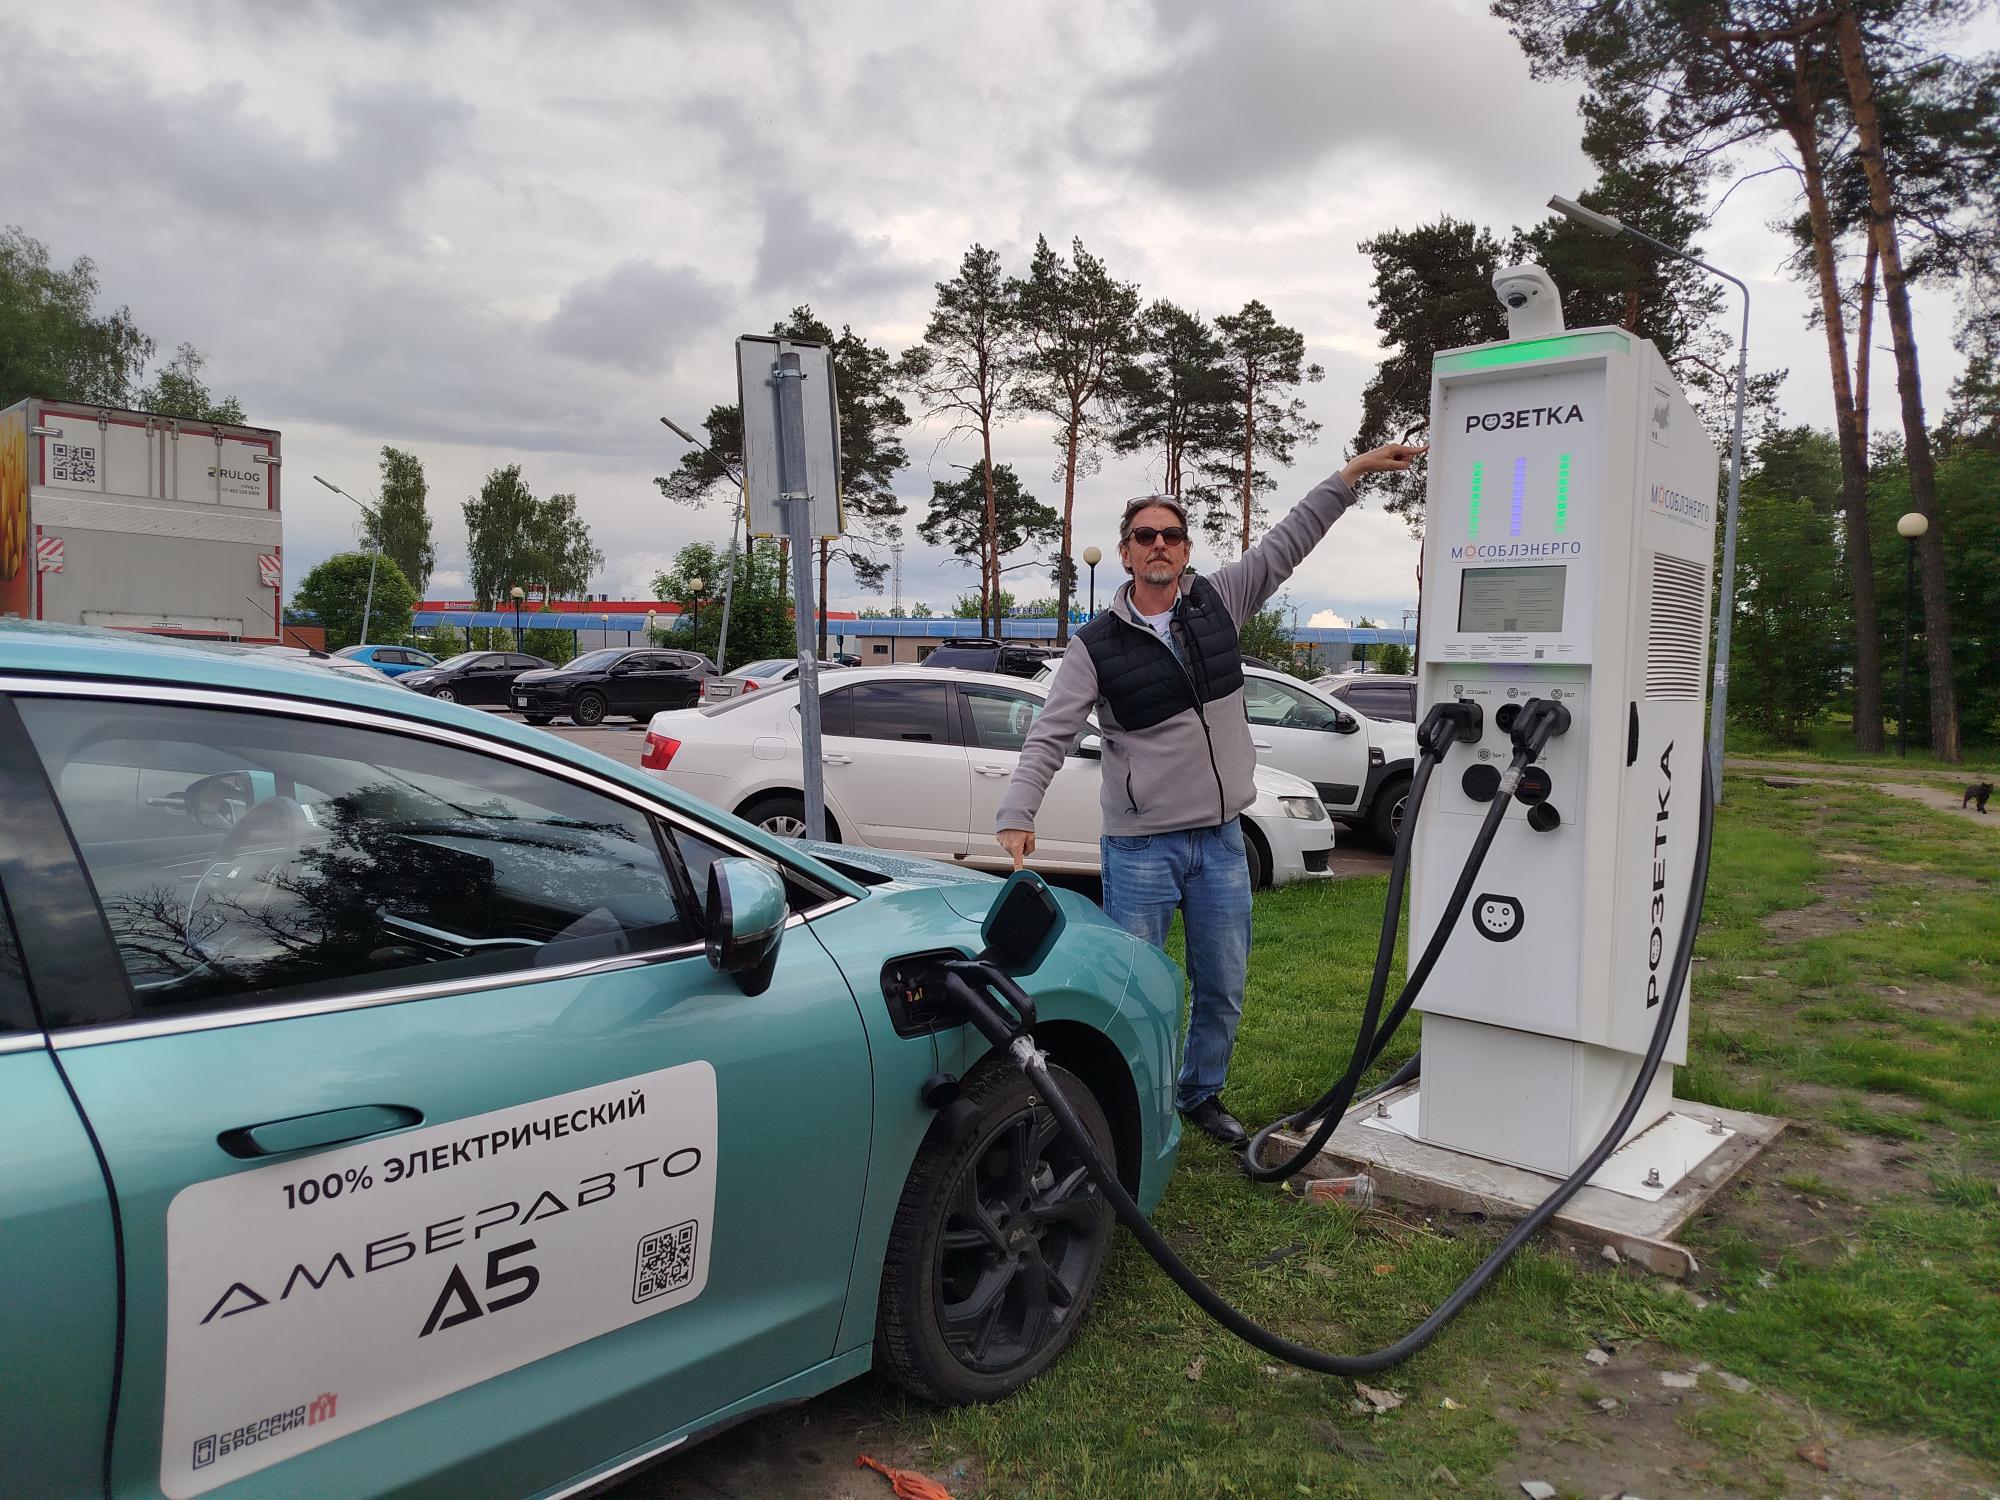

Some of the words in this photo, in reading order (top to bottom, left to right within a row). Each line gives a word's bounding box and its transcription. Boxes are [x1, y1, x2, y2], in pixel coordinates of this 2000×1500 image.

[1466, 404, 1584, 433] РОЗЕТКА
[220, 469, 260, 481] RULOG
[1651, 484, 1709, 522] МОСОБЛЭНЕРГО
[1451, 541, 1581, 559] МОСОБЛЭНЕРГО
[1646, 739, 1675, 1009] РОЗЕТКА
[283, 1164, 374, 1209] 100%
[383, 1089, 647, 1183] ЭЛЕКТРИЧЕСКИЙ
[199, 1146, 702, 1325] АМБЕРАВТО
[219, 1405, 306, 1444] СДЕЛАНО
[234, 1415, 305, 1451] РОССИИ
